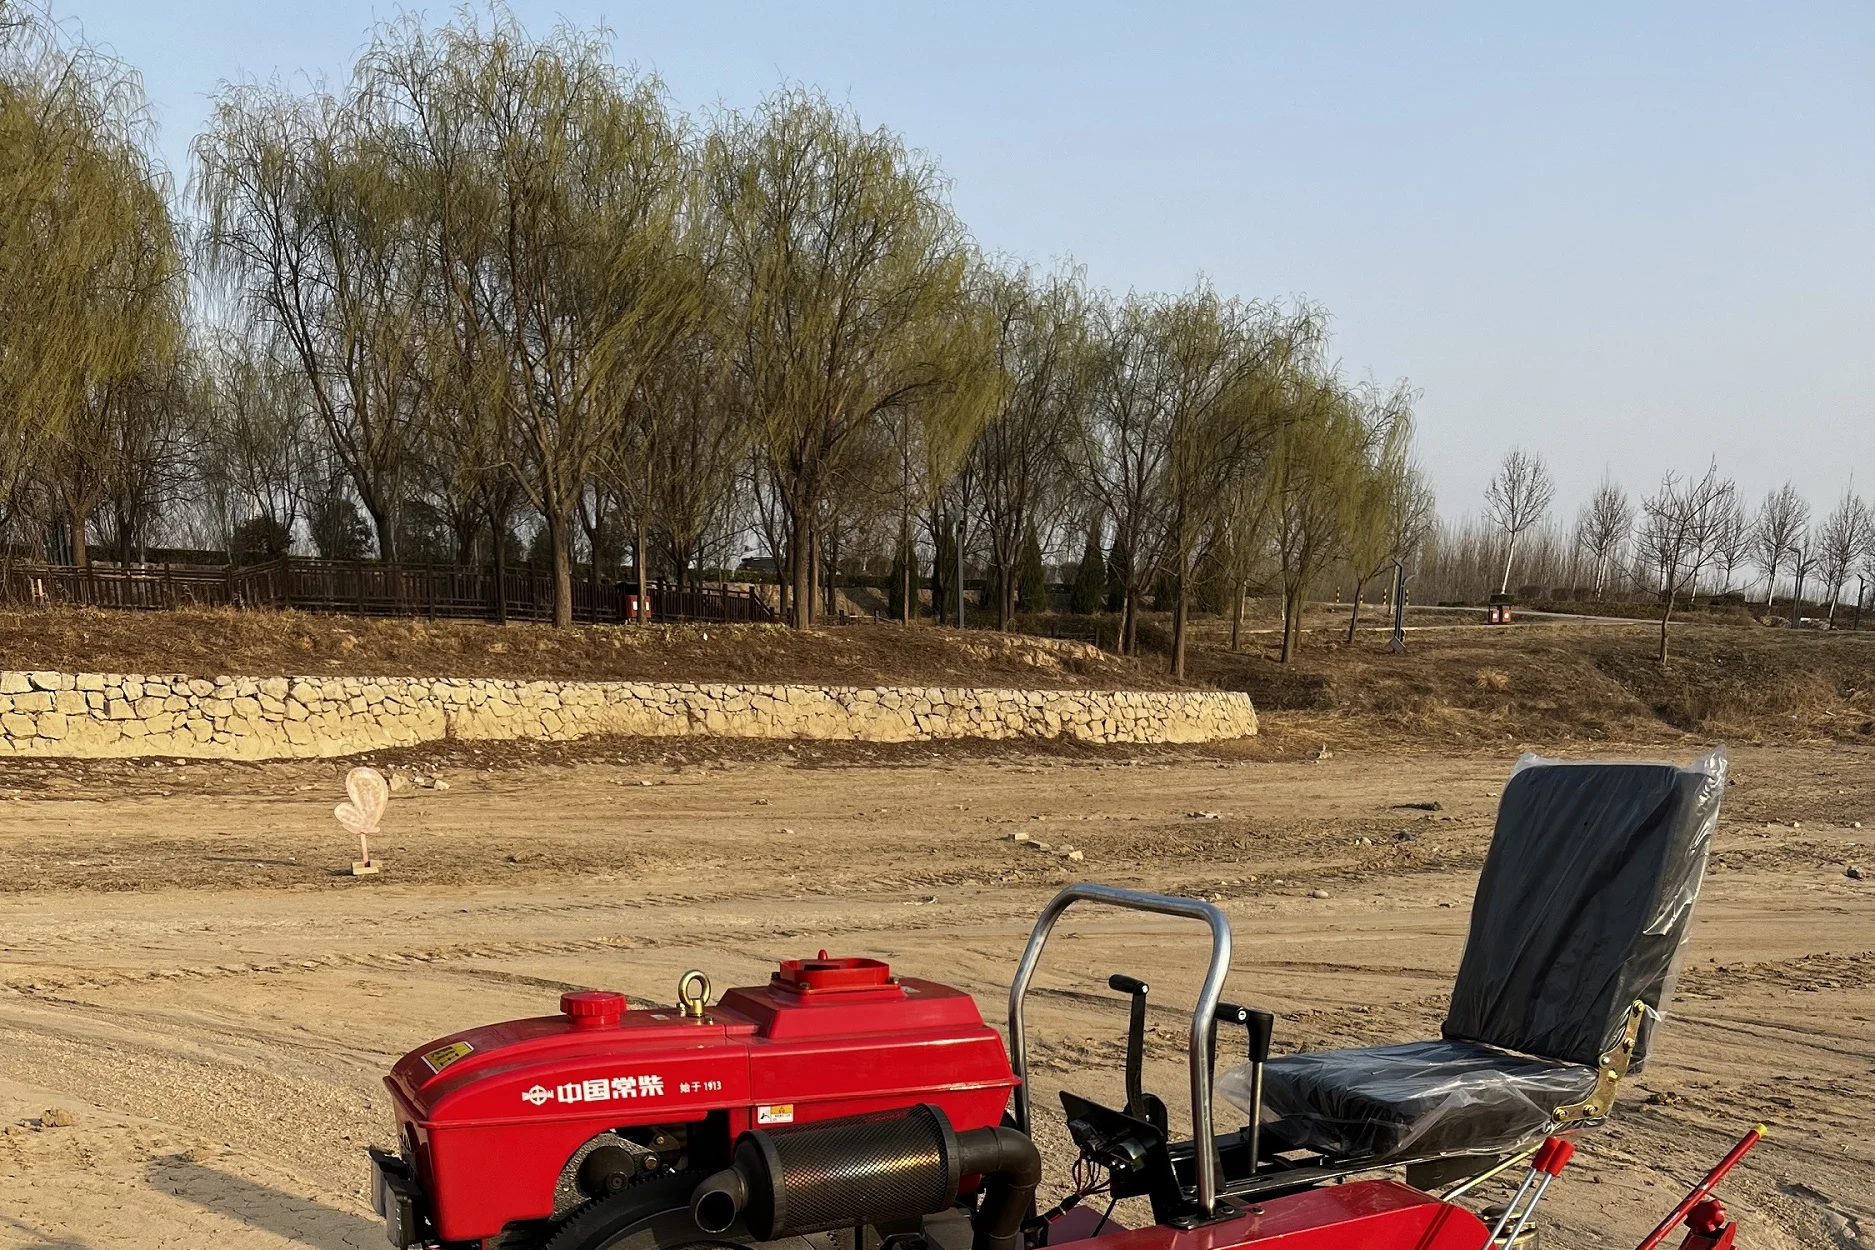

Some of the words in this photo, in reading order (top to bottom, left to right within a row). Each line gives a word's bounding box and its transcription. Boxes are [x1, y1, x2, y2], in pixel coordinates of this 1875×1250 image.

[556, 1075, 664, 1104] 中国常柴
[679, 1081, 702, 1093] 始于
[703, 1080, 722, 1091] 1913
